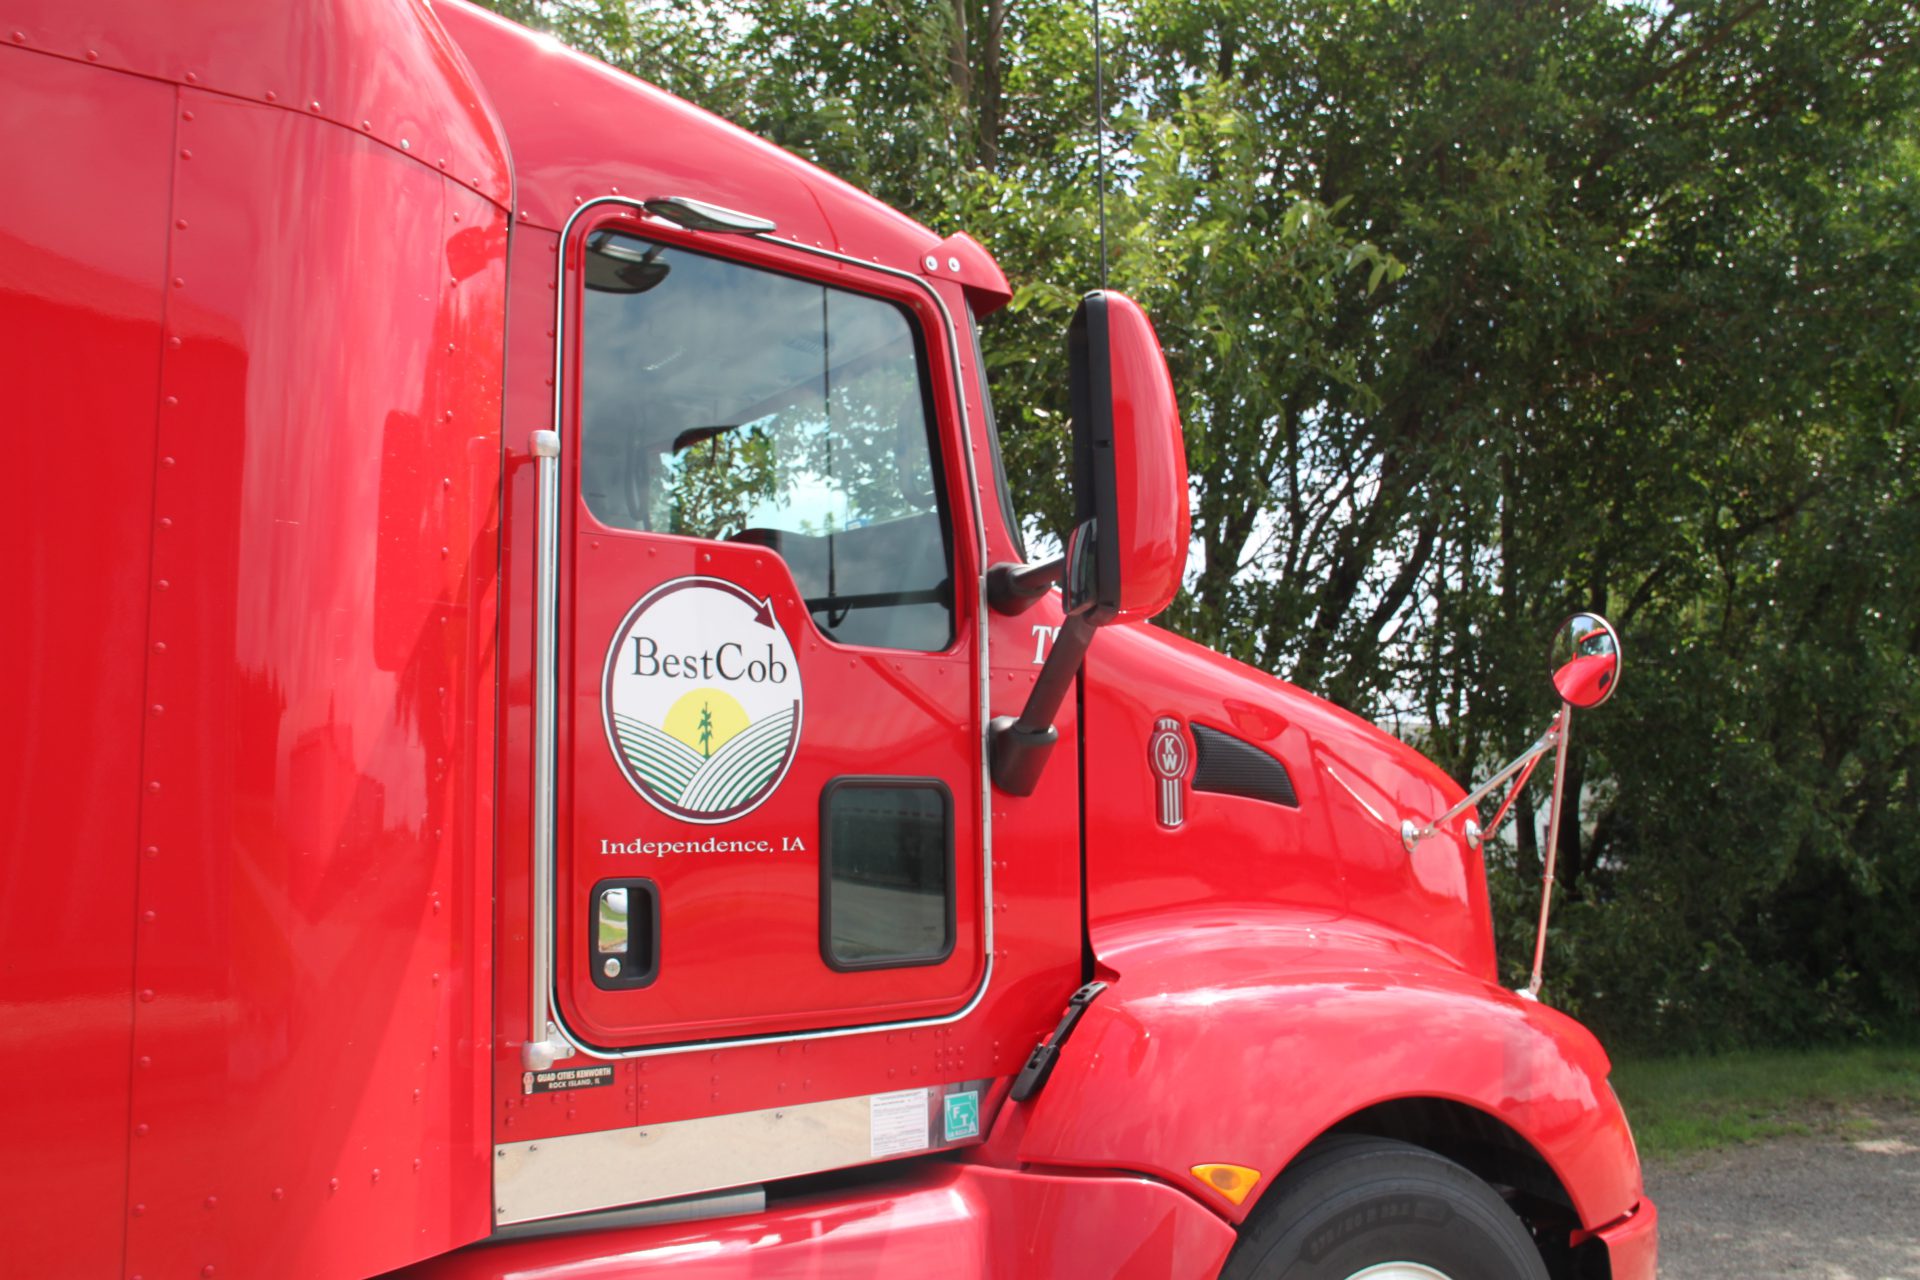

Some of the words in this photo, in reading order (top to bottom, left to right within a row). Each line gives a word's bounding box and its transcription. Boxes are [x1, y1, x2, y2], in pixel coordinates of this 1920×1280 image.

[631, 636, 787, 683] BestCob
[600, 837, 774, 857] Independence,
[782, 837, 806, 851] IA
[537, 1072, 556, 1082] QUAD
[557, 1070, 575, 1080] CITIES
[576, 1067, 611, 1078] KENWORTH
[548, 1081, 567, 1089] ROCK
